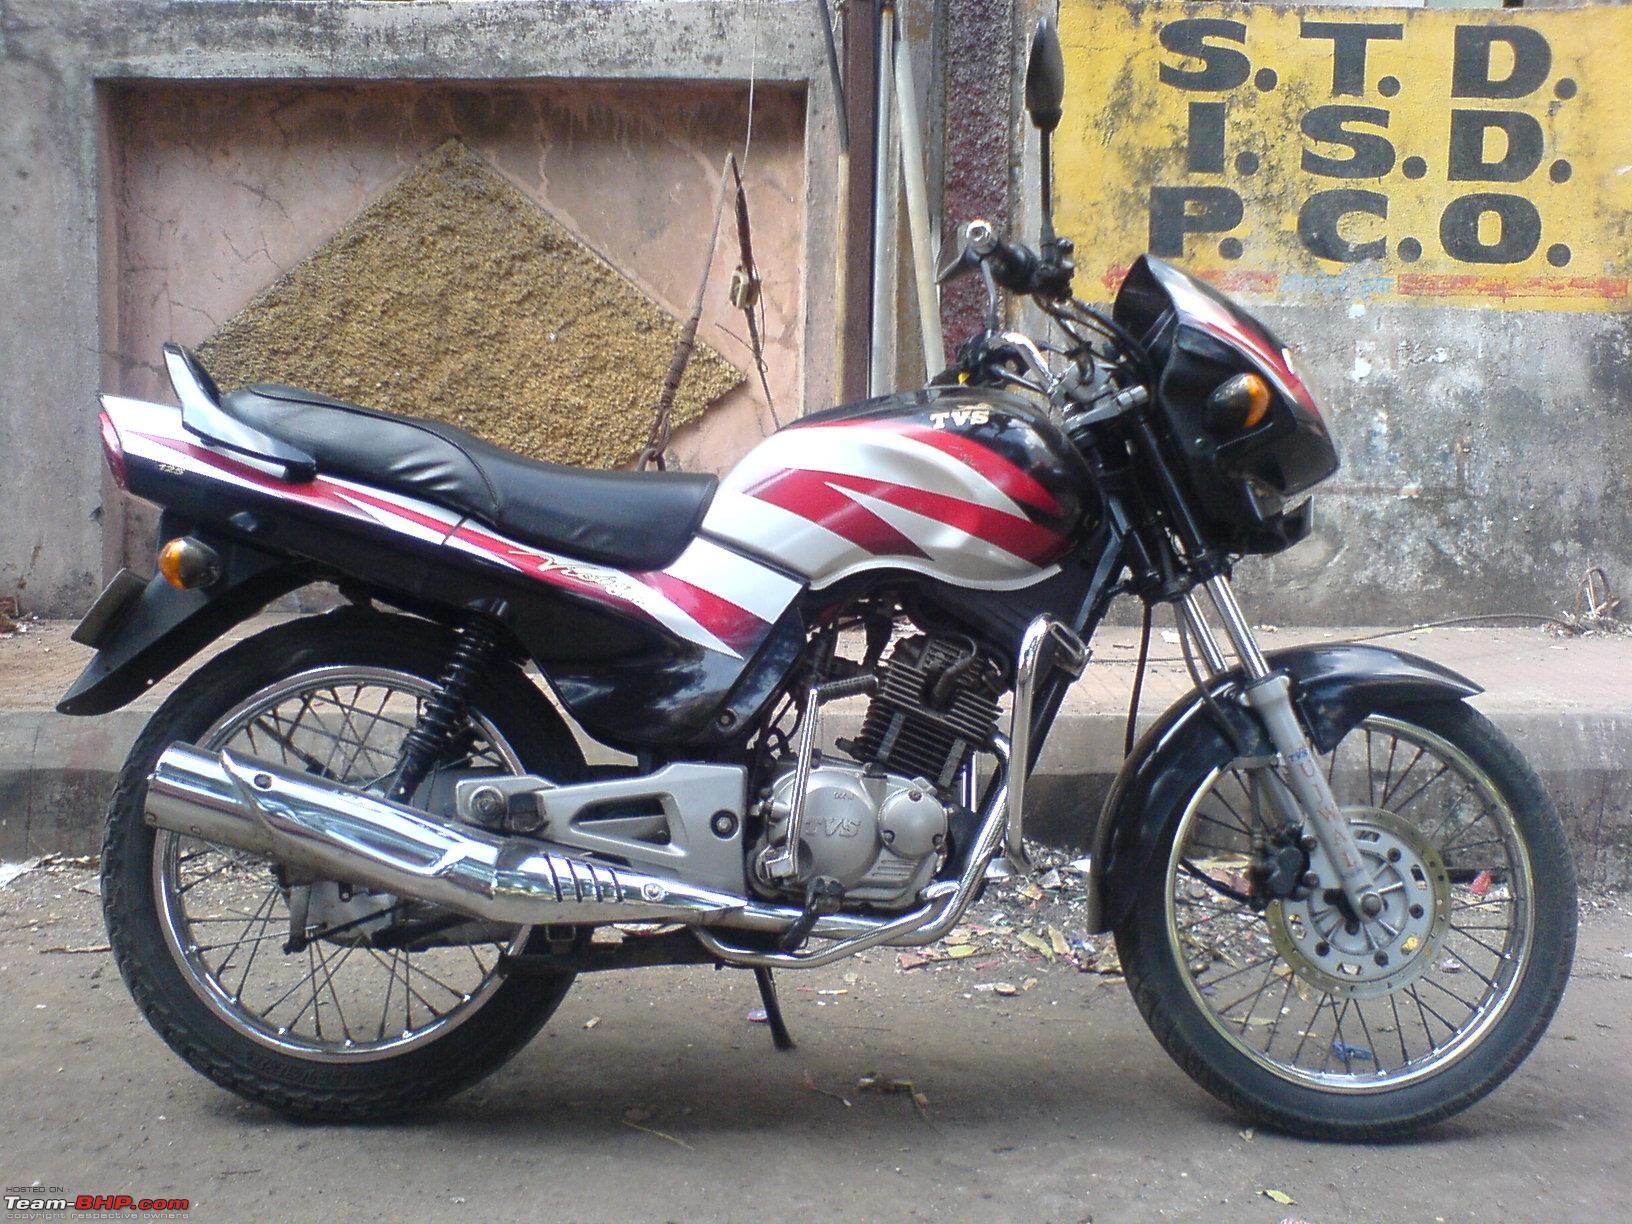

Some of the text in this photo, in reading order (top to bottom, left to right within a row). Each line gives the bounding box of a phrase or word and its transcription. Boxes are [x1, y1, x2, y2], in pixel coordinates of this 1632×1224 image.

[1158, 18, 1577, 99] S.T.D.
[1187, 101, 1573, 184] I.S.D.
[1149, 185, 1571, 268] P.C.O.
[929, 410, 990, 430] TVS
[804, 815, 862, 838] TVS
